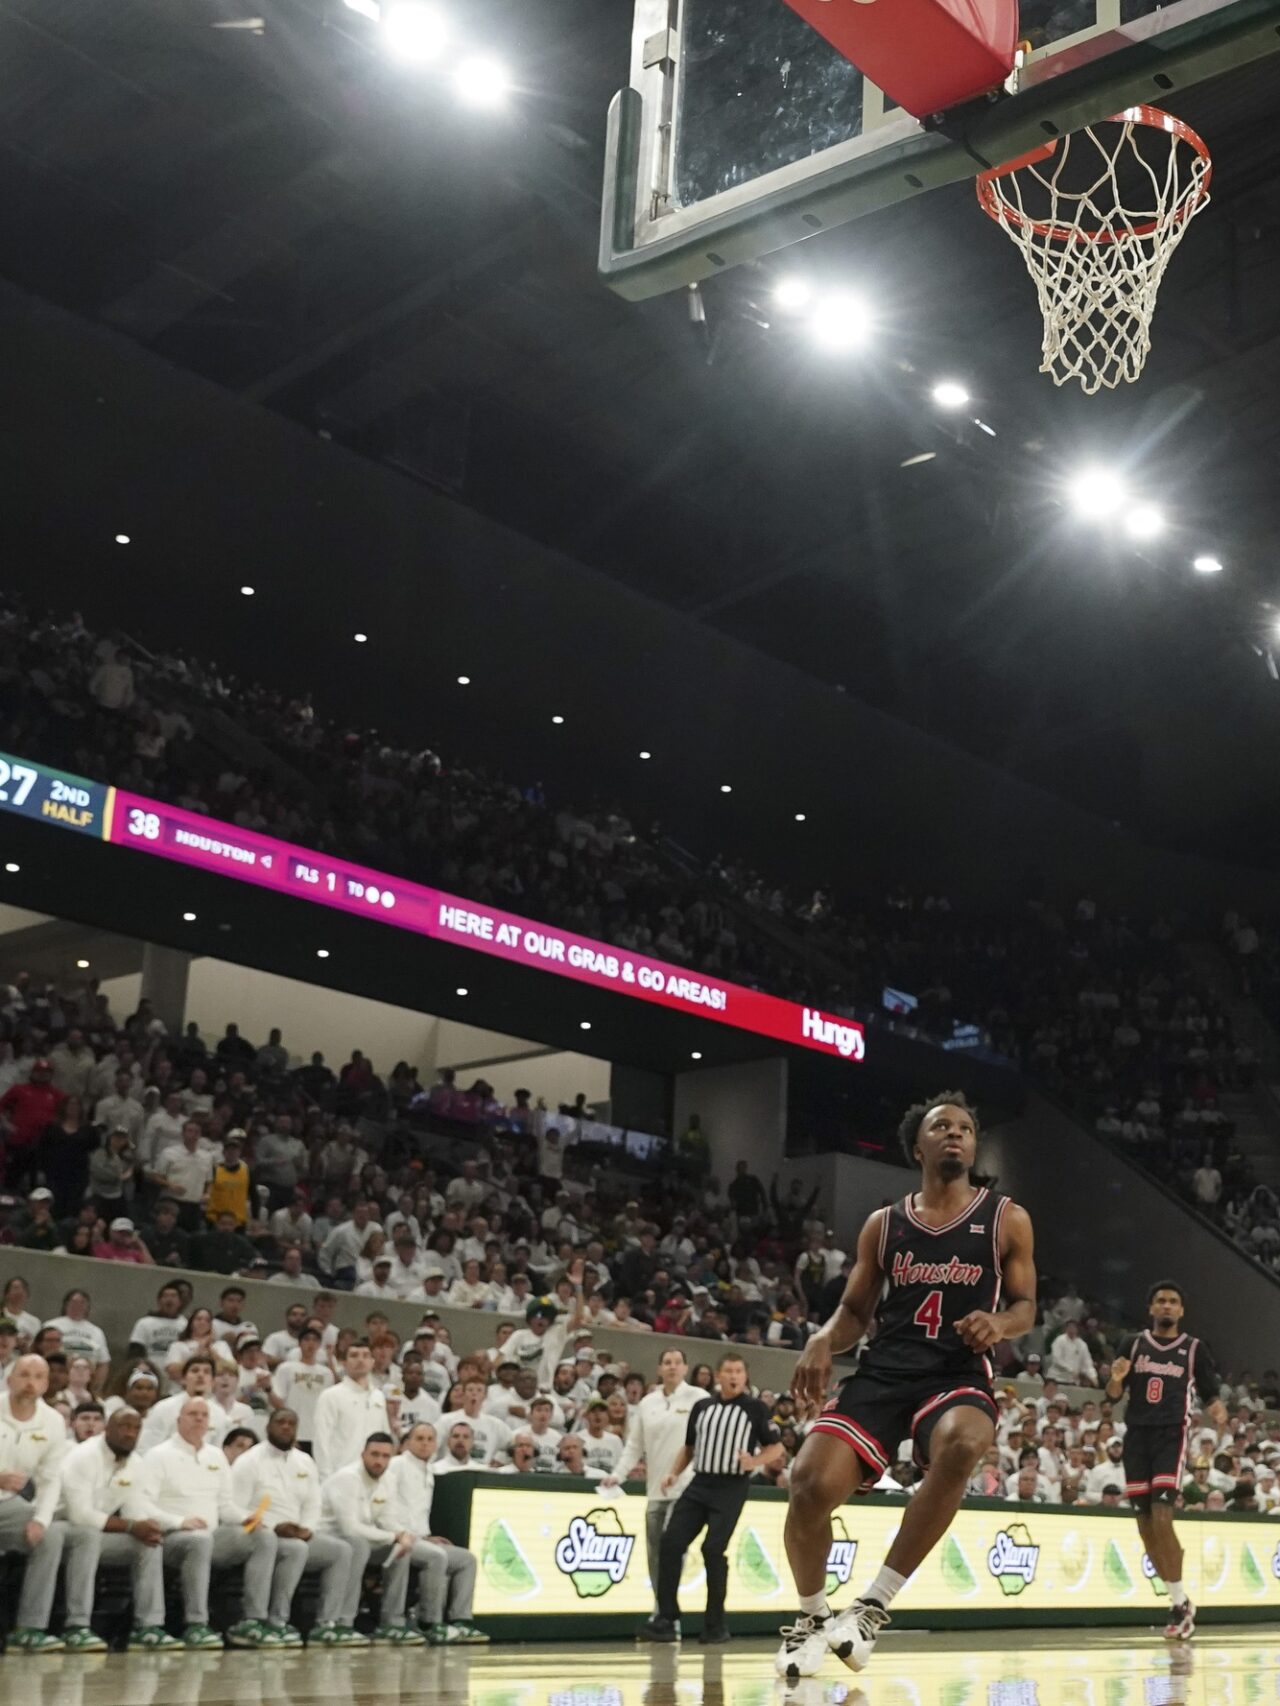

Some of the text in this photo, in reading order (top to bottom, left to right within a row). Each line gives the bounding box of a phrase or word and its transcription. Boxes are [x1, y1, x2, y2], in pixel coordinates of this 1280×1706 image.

[50, 780, 90, 807] 2ND
[42, 800, 94, 827] HALF
[128, 808, 160, 840] 38
[175, 829, 256, 865] HOUSTON
[295, 864, 337, 892] FLS 1
[439, 904, 727, 1011] HERE AT OUR GRAB & GO AREAS!
[892, 1250, 982, 1287] Houston
[914, 1290, 943, 1339] 4
[1146, 1376, 1164, 1404] 8
[555, 1516, 636, 1584] Starry
